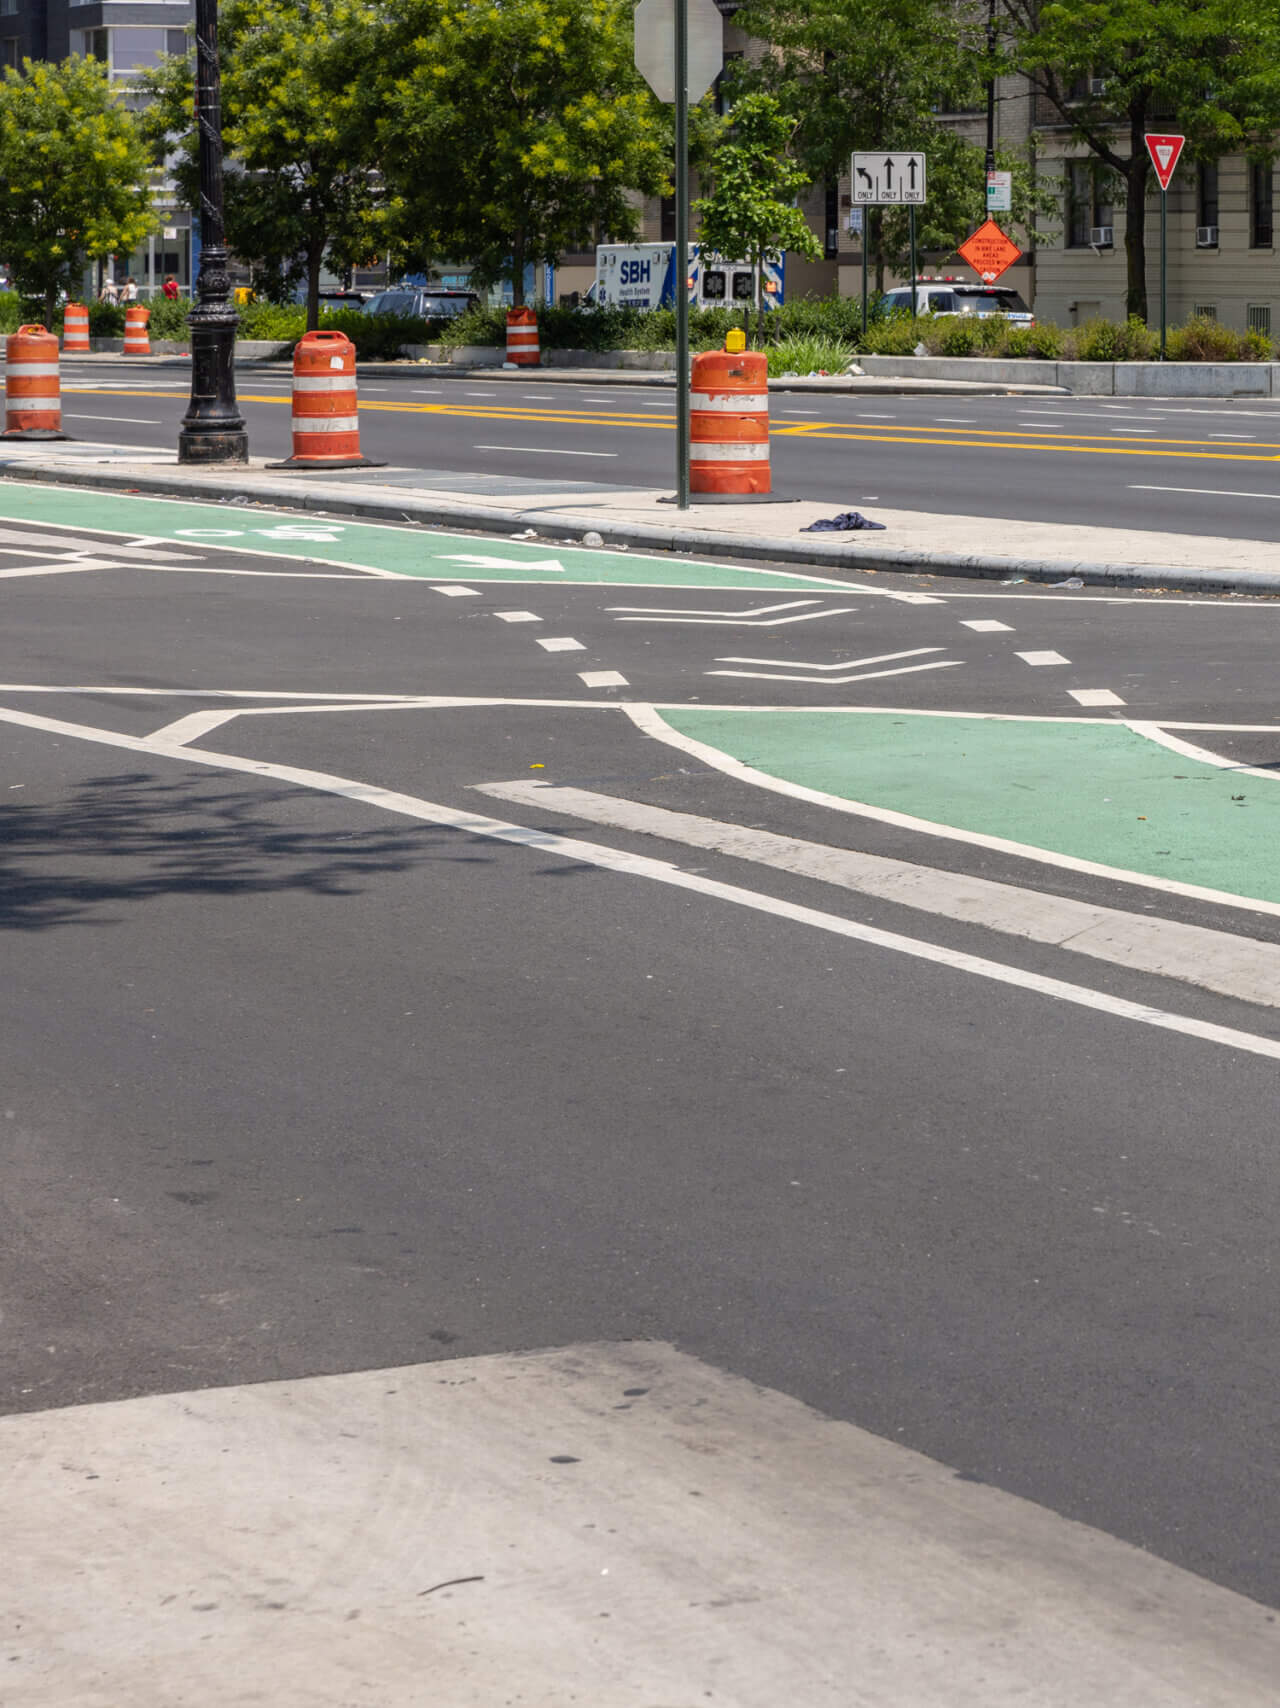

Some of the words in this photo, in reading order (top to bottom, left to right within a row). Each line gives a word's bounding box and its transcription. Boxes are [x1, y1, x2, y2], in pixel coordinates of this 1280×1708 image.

[857, 191, 873, 200] ONLY
[881, 191, 897, 200] ONLY
[904, 191, 920, 200] ONLY
[620, 260, 651, 285] SBH
[634, 287, 650, 297] System
